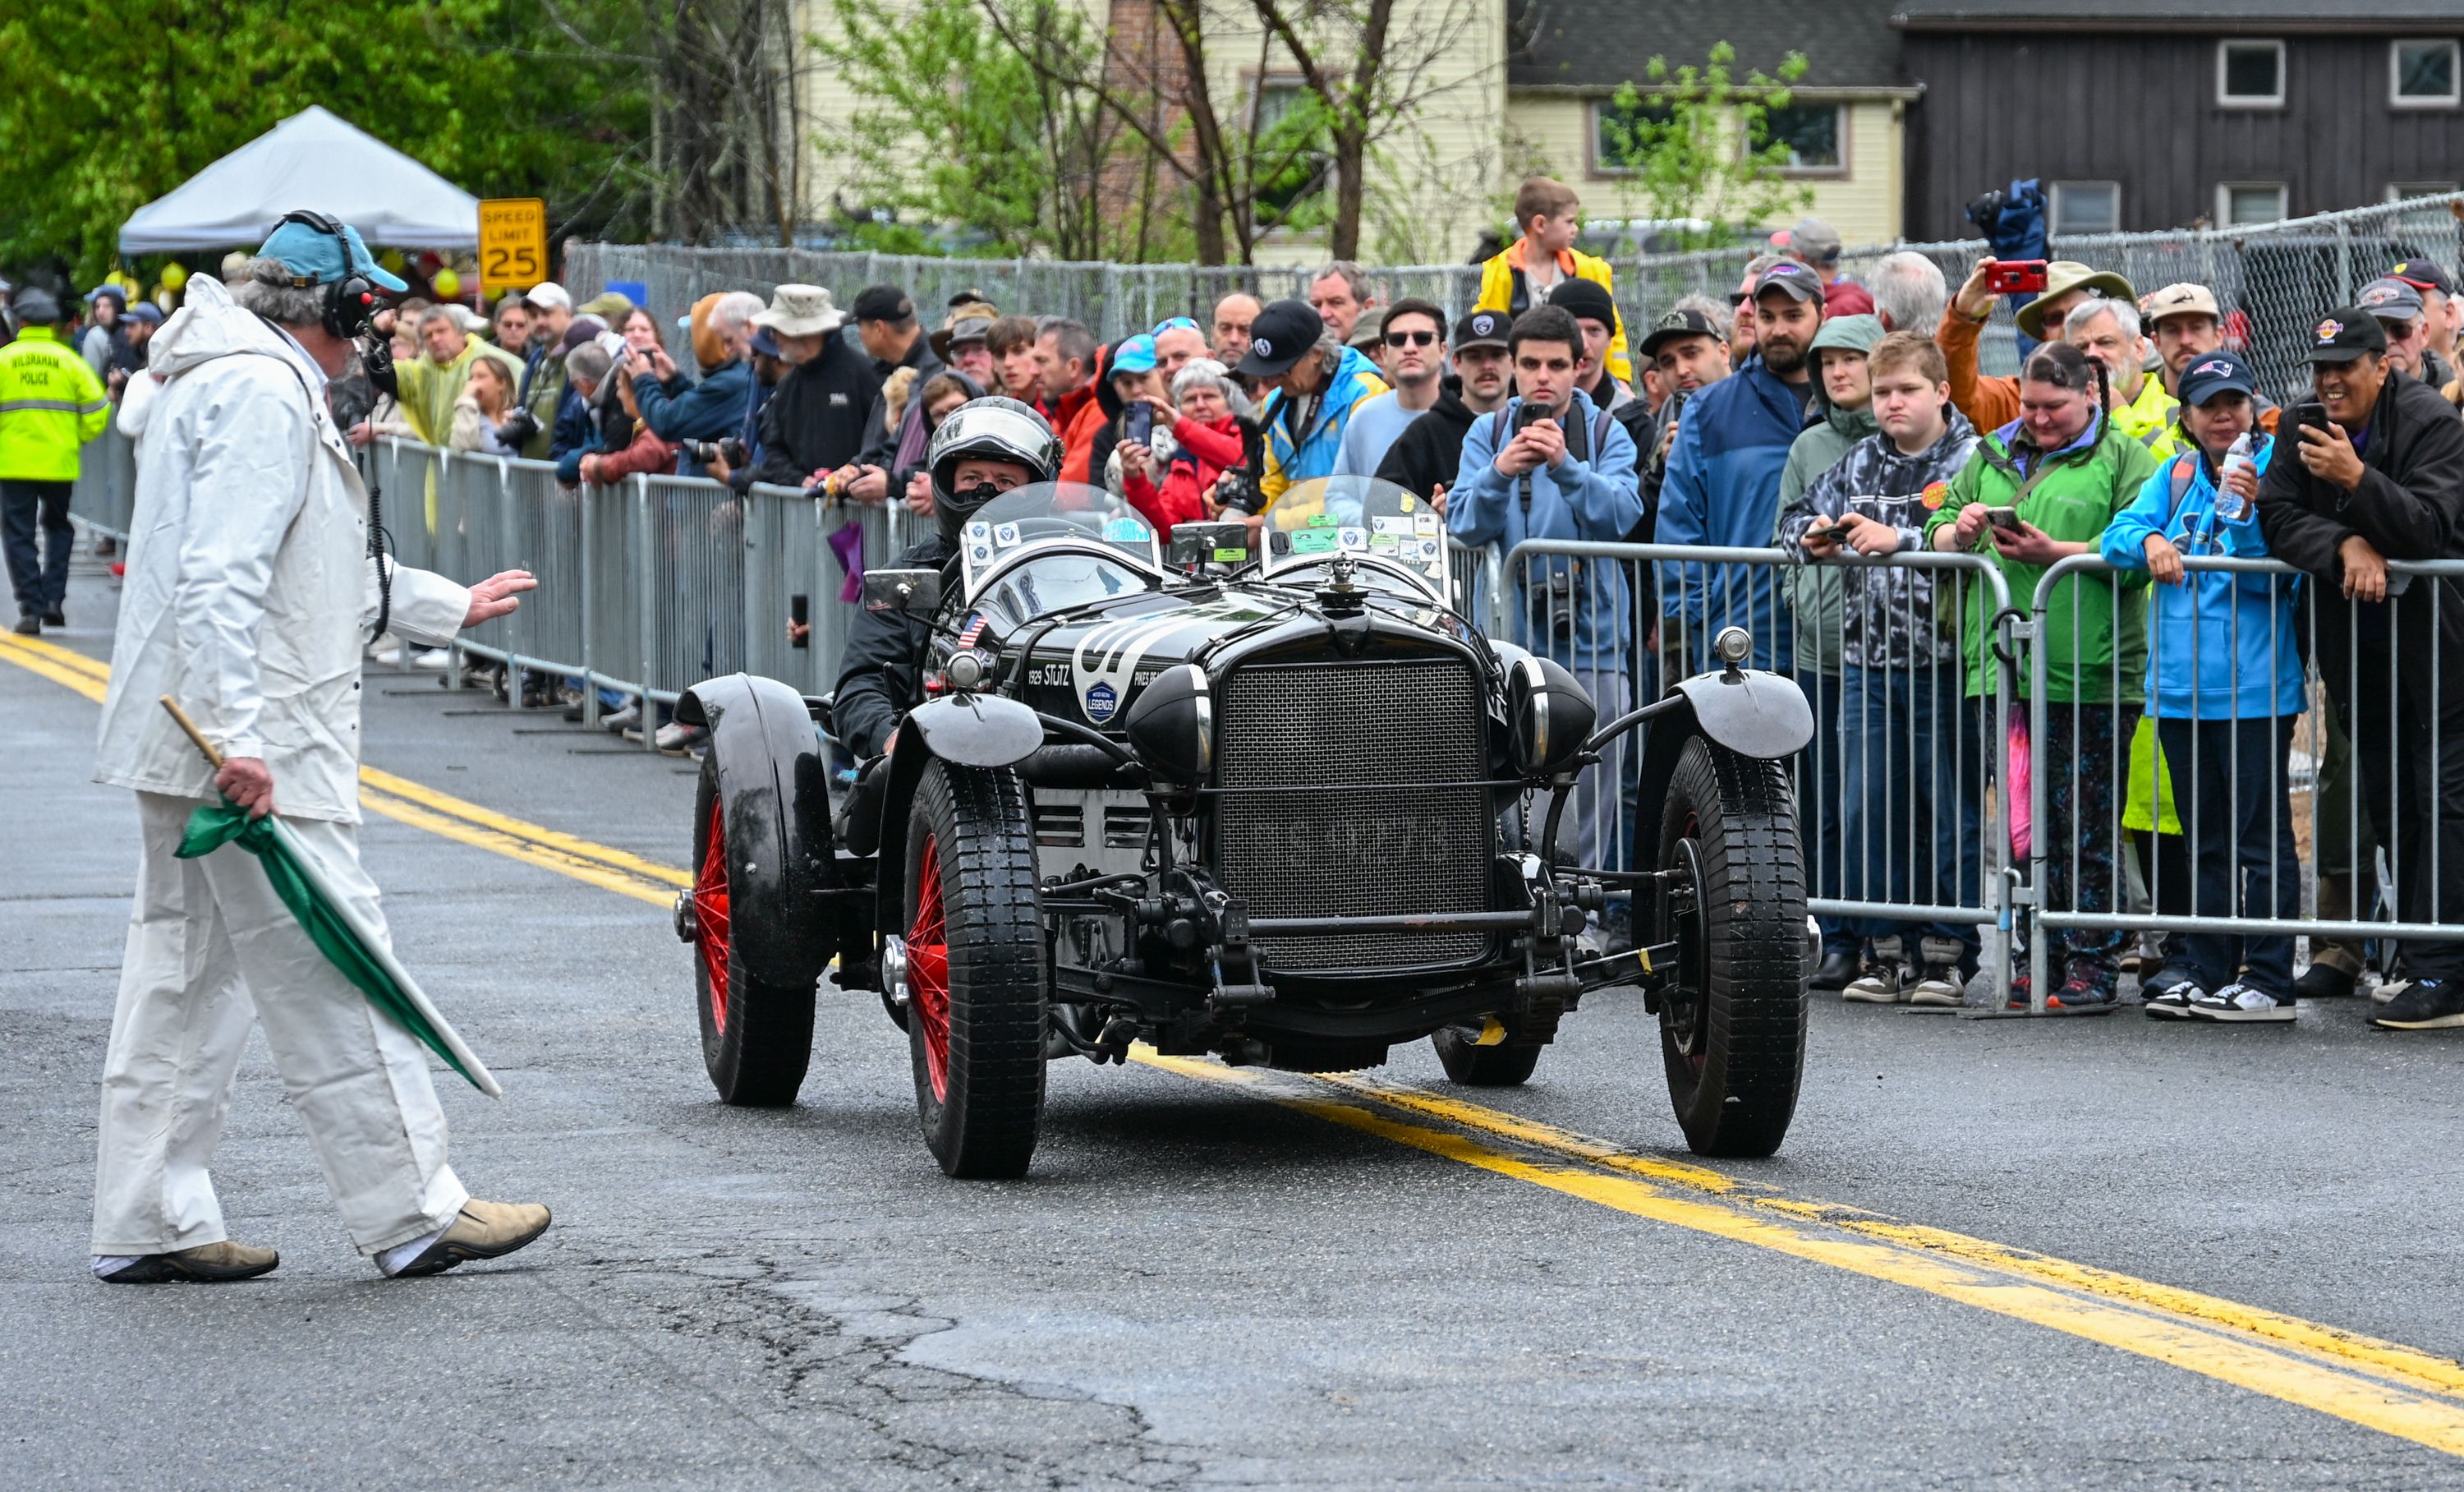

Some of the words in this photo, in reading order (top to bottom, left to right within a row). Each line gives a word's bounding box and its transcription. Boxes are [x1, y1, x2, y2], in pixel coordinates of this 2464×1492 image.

[483, 210, 535, 223] SPEED
[489, 228, 530, 243] LIMIT
[487, 248, 536, 277] 25
[20, 371, 48, 385] POLICE
[1028, 670, 1042, 685] 1929
[1134, 671, 1149, 686] PIKES
[1088, 699, 1114, 711] LEGENDS
